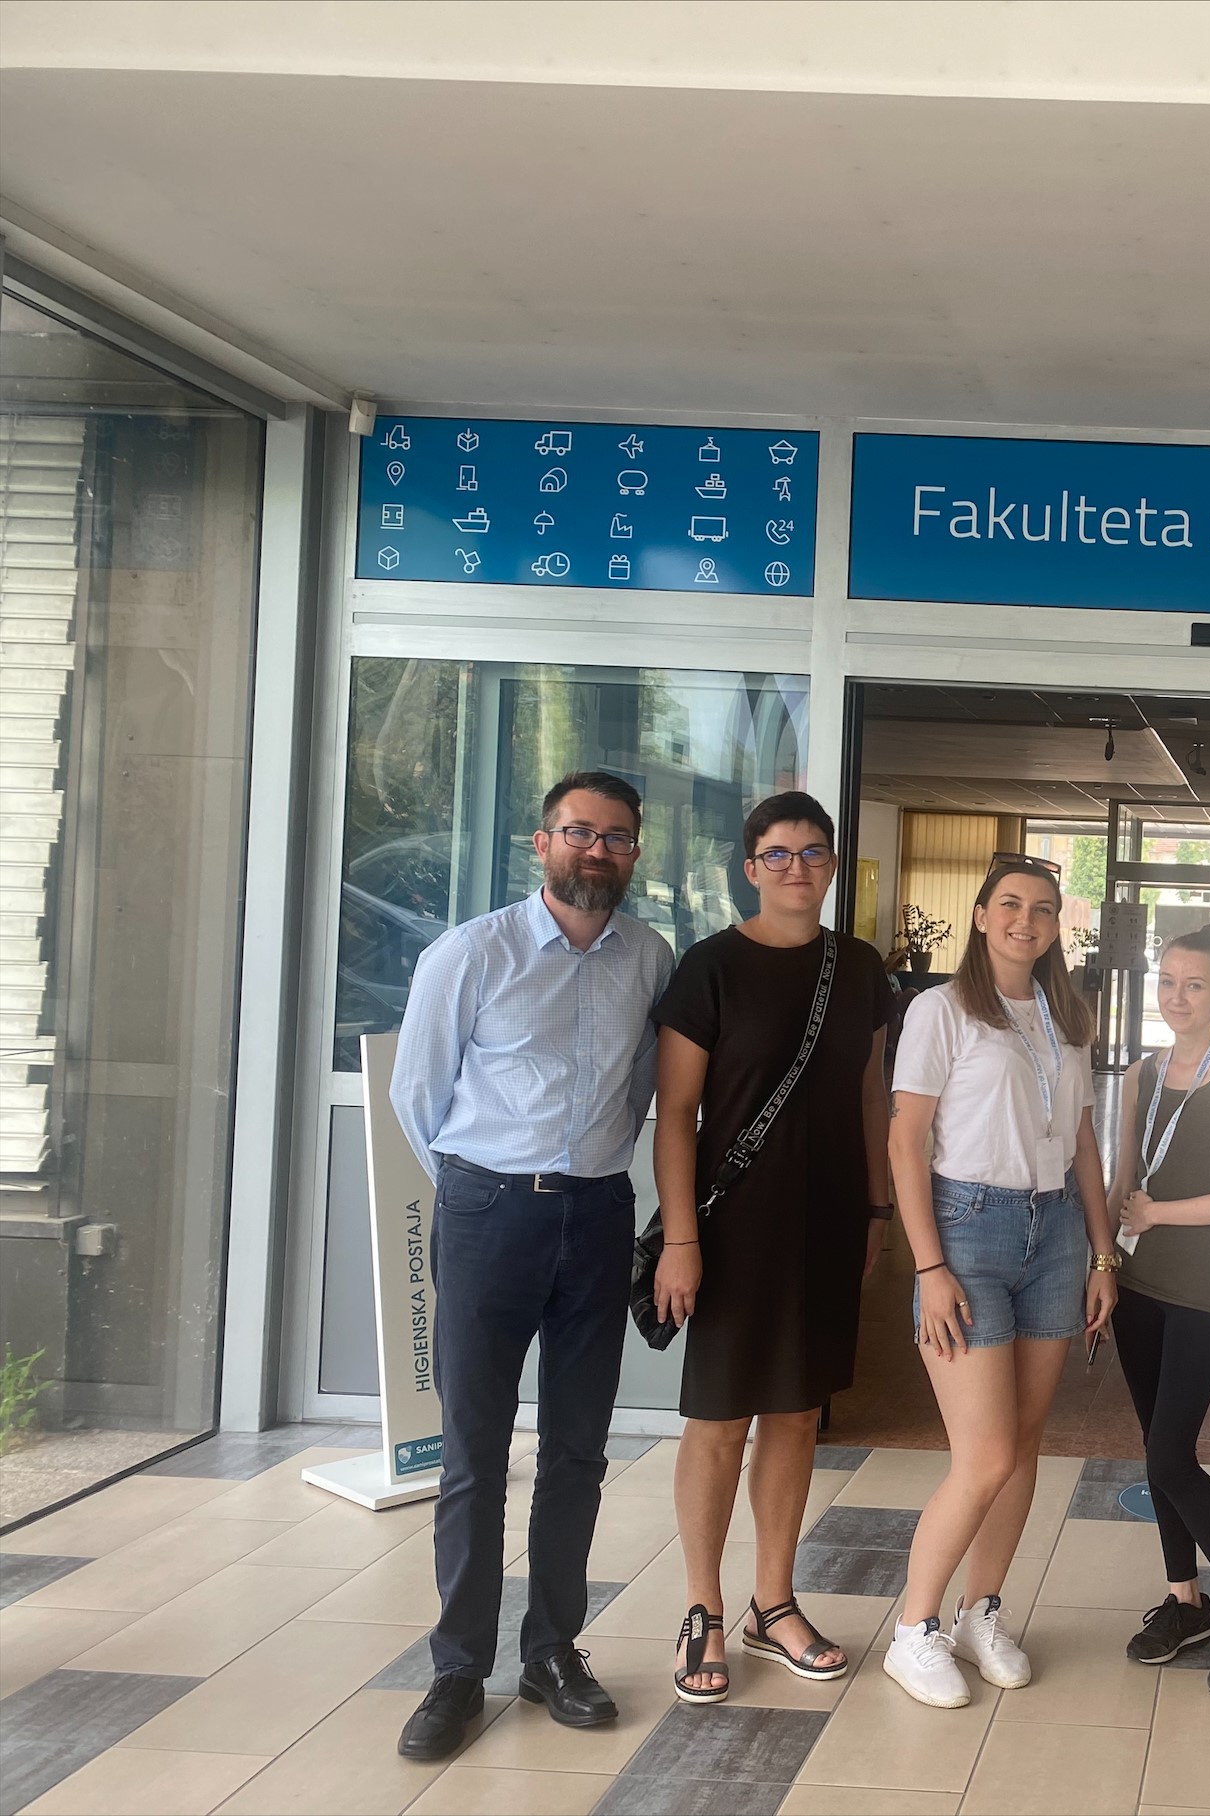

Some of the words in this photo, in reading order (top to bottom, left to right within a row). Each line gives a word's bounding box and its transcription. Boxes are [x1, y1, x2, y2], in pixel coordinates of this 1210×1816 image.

[779, 519, 795, 531] 24
[912, 484, 1193, 549] Fakulteta
[1036, 989, 1047, 1013] LOGISTIKO
[1043, 1012, 1049, 1020] ZA
[763, 1104, 776, 1118] Be
[772, 1064, 801, 1106] grateful.
[807, 1023, 817, 1036] Be
[826, 947, 834, 958] Be
[1016, 1028, 1032, 1052] FACULTY
[1044, 1020, 1057, 1048] FAKULTETA
[406, 1199, 424, 1284] POSTAJA
[411, 1288, 430, 1393] HIGIENSKA
